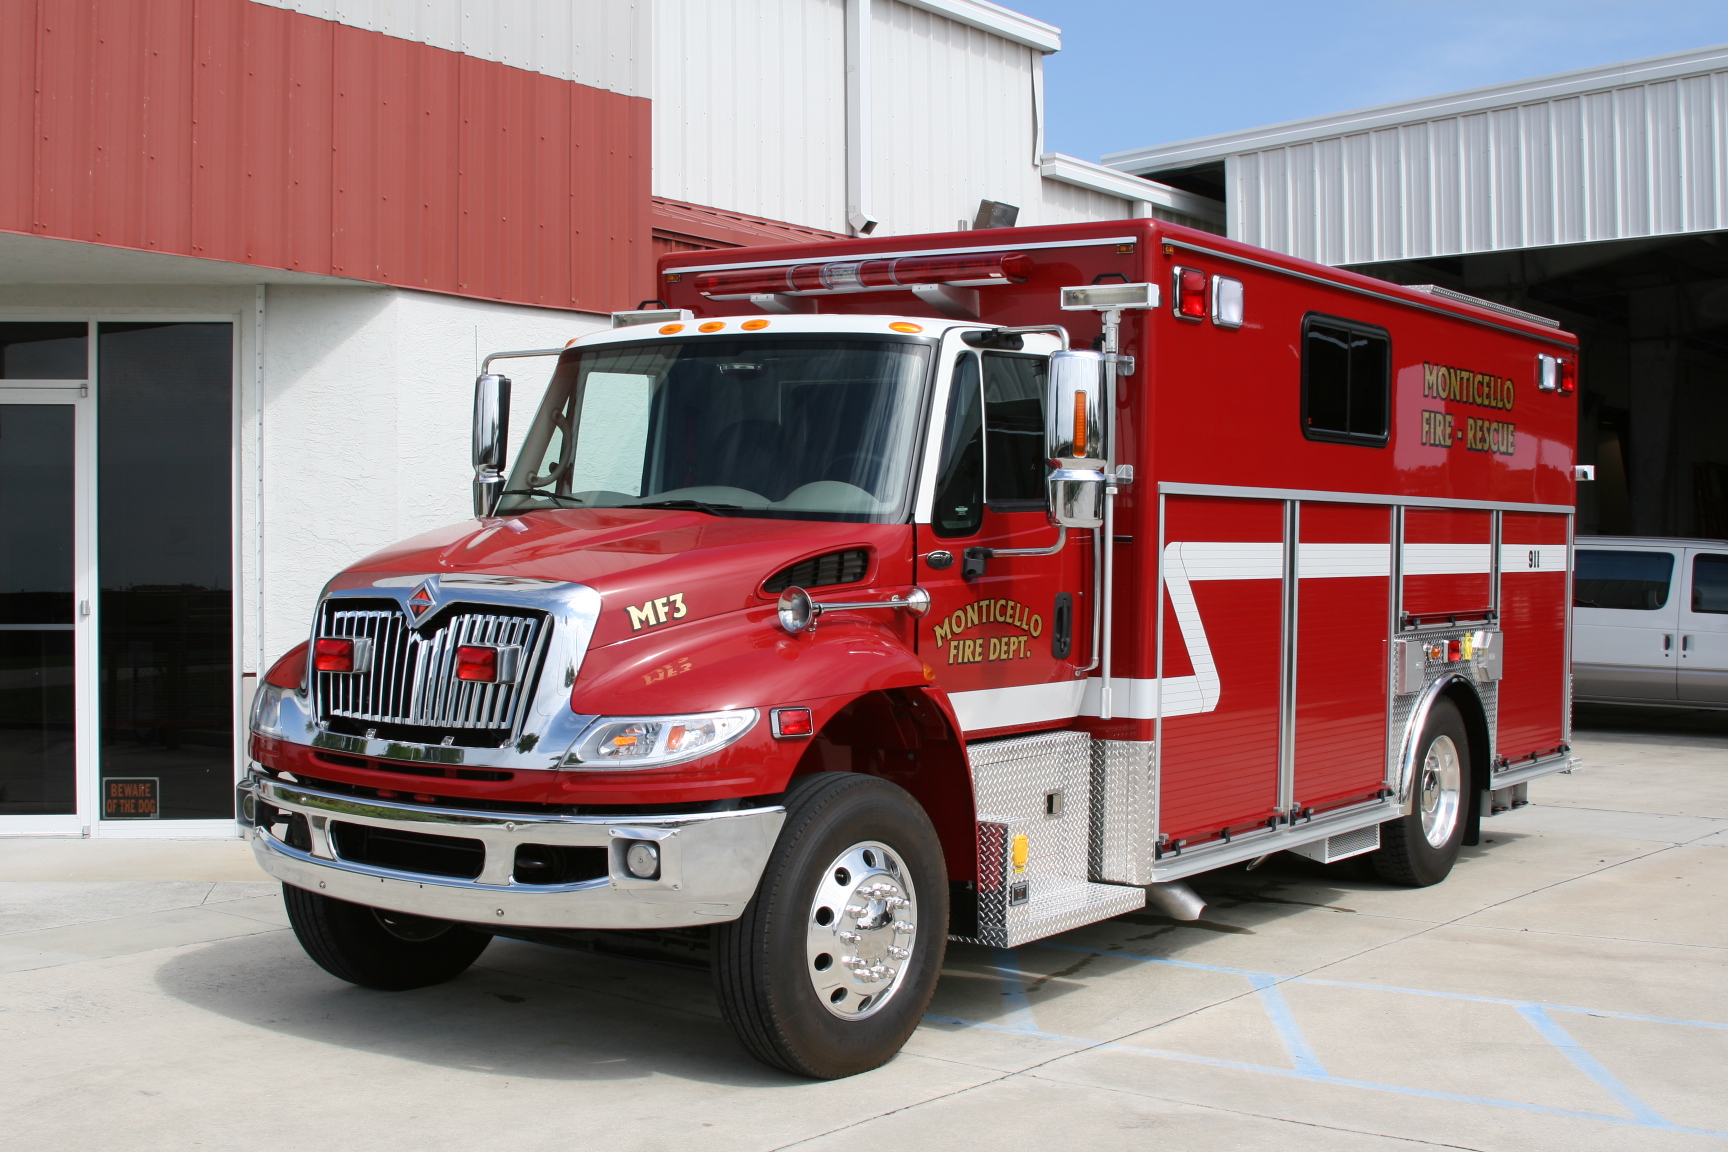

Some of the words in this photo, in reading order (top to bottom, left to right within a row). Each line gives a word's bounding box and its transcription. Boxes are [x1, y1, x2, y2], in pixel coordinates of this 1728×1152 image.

[1423, 361, 1514, 411] MONTICELLO
[1421, 409, 1453, 448] FIRE
[1466, 416, 1515, 455] RESCUE
[1528, 550, 1540, 568] 911
[624, 592, 687, 632] MF3
[932, 598, 1042, 648] MONTICELLO
[948, 638, 984, 665] FIRE
[988, 635, 1031, 662] DEPT.
[106, 799, 118, 813] OF
[119, 799, 136, 813] THE
[138, 799, 156, 813] DOG
[110, 783, 151, 797] BEWARE
